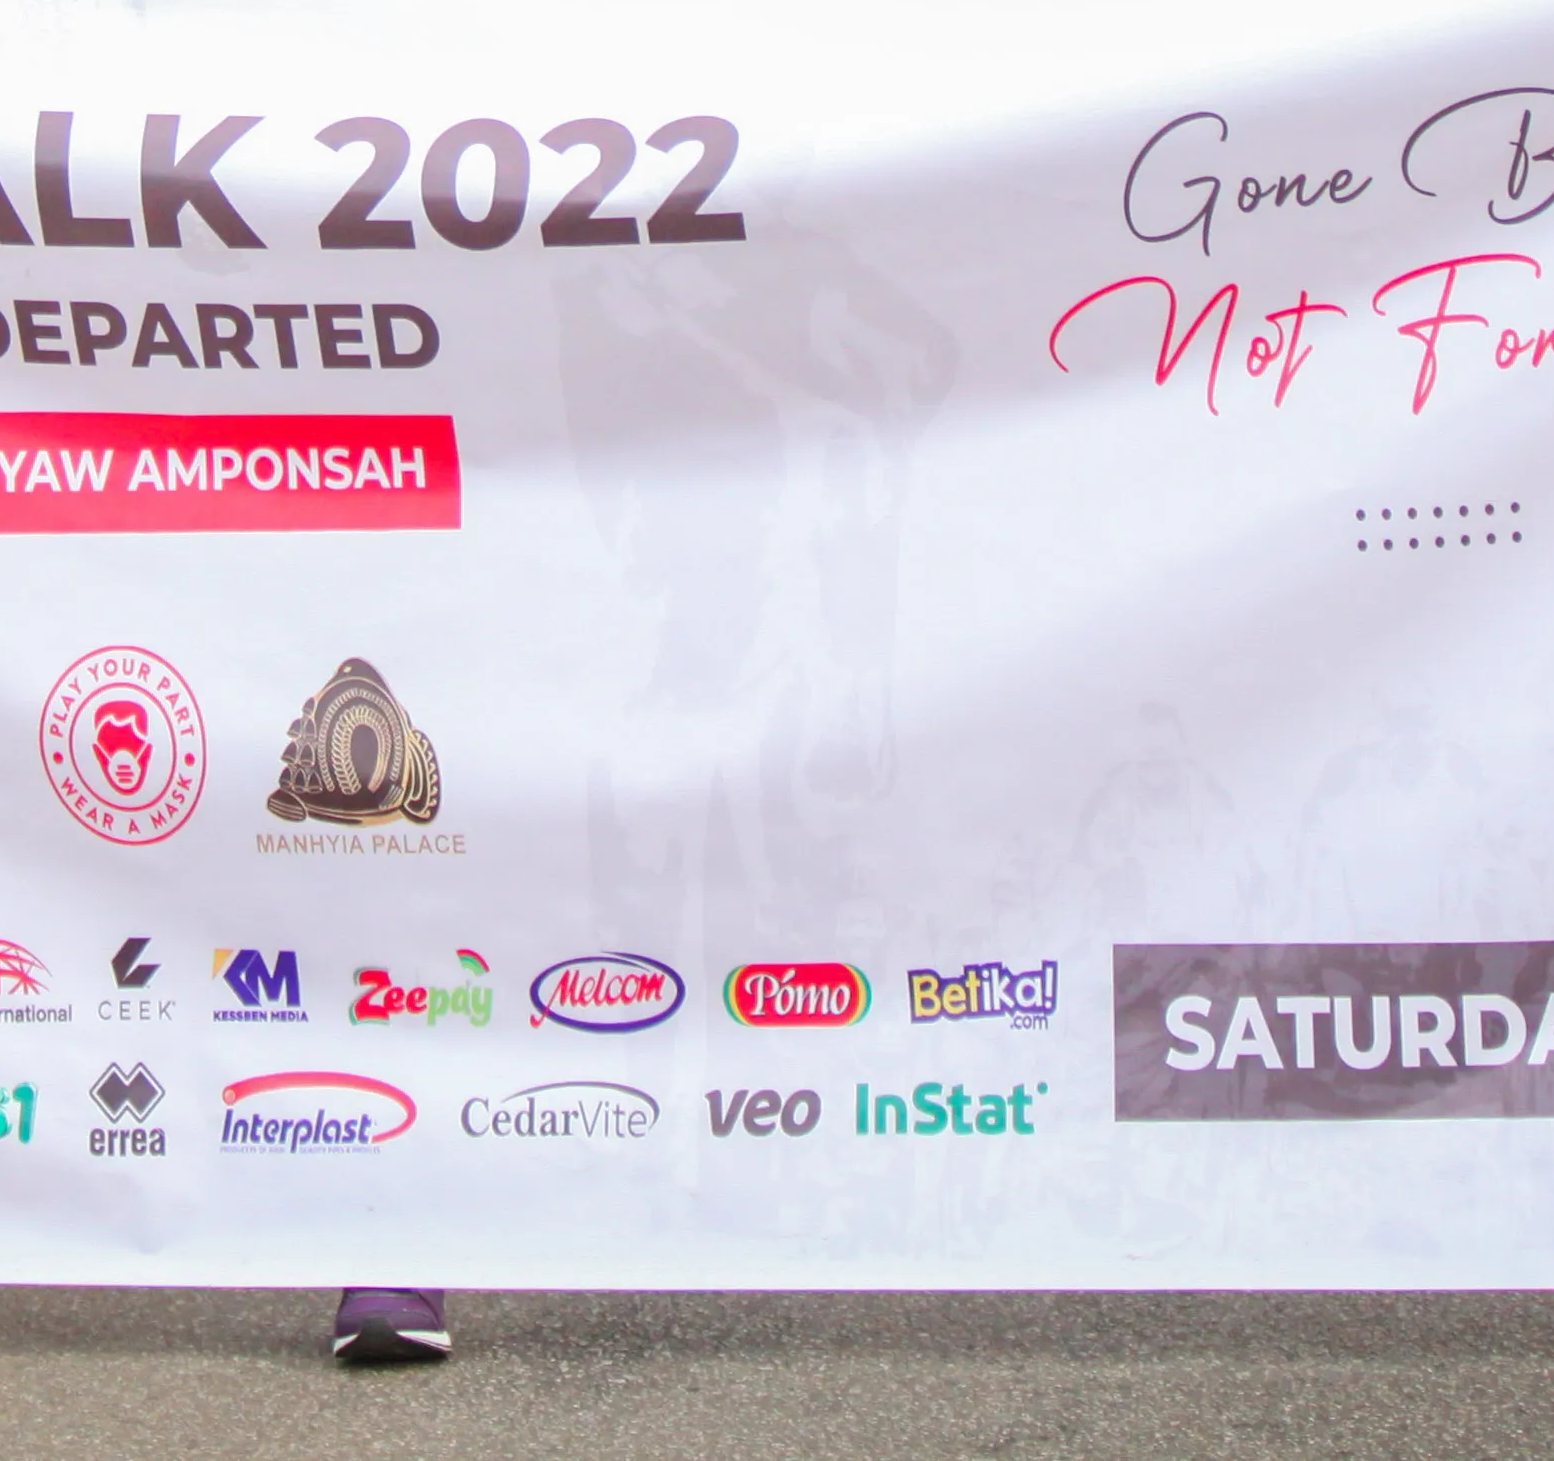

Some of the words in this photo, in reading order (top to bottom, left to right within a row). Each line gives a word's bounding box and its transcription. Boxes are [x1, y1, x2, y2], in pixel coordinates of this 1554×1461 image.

[314, 115, 748, 252] 2022
[1124, 111, 1373, 257] Gone
[1049, 276, 1347, 416] Not
[127, 446, 427, 493] AMPONSAH
[49, 678, 82, 739] PLAY
[88, 658, 152, 682] YOUR
[156, 676, 196, 737] PART
[61, 777, 115, 831] WEAR
[128, 819, 141, 835] A
[149, 773, 193, 830] MASK
[256, 834, 365, 855] MANHYIA
[372, 834, 467, 855] PALACE
[97, 999, 176, 1021] CEEK
[348, 966, 493, 1027] Zeepay
[530, 968, 665, 1027] Melcom
[744, 968, 851, 1017] Pómo
[914, 965, 1053, 1017] Betika!
[270, 1010, 310, 1023] MEDIA
[1009, 1013, 1049, 1031] .com
[221, 1108, 372, 1154] Interplast
[461, 1096, 648, 1139] CedarVite
[704, 1089, 822, 1138] veo
[855, 1082, 1035, 1136] InStat
